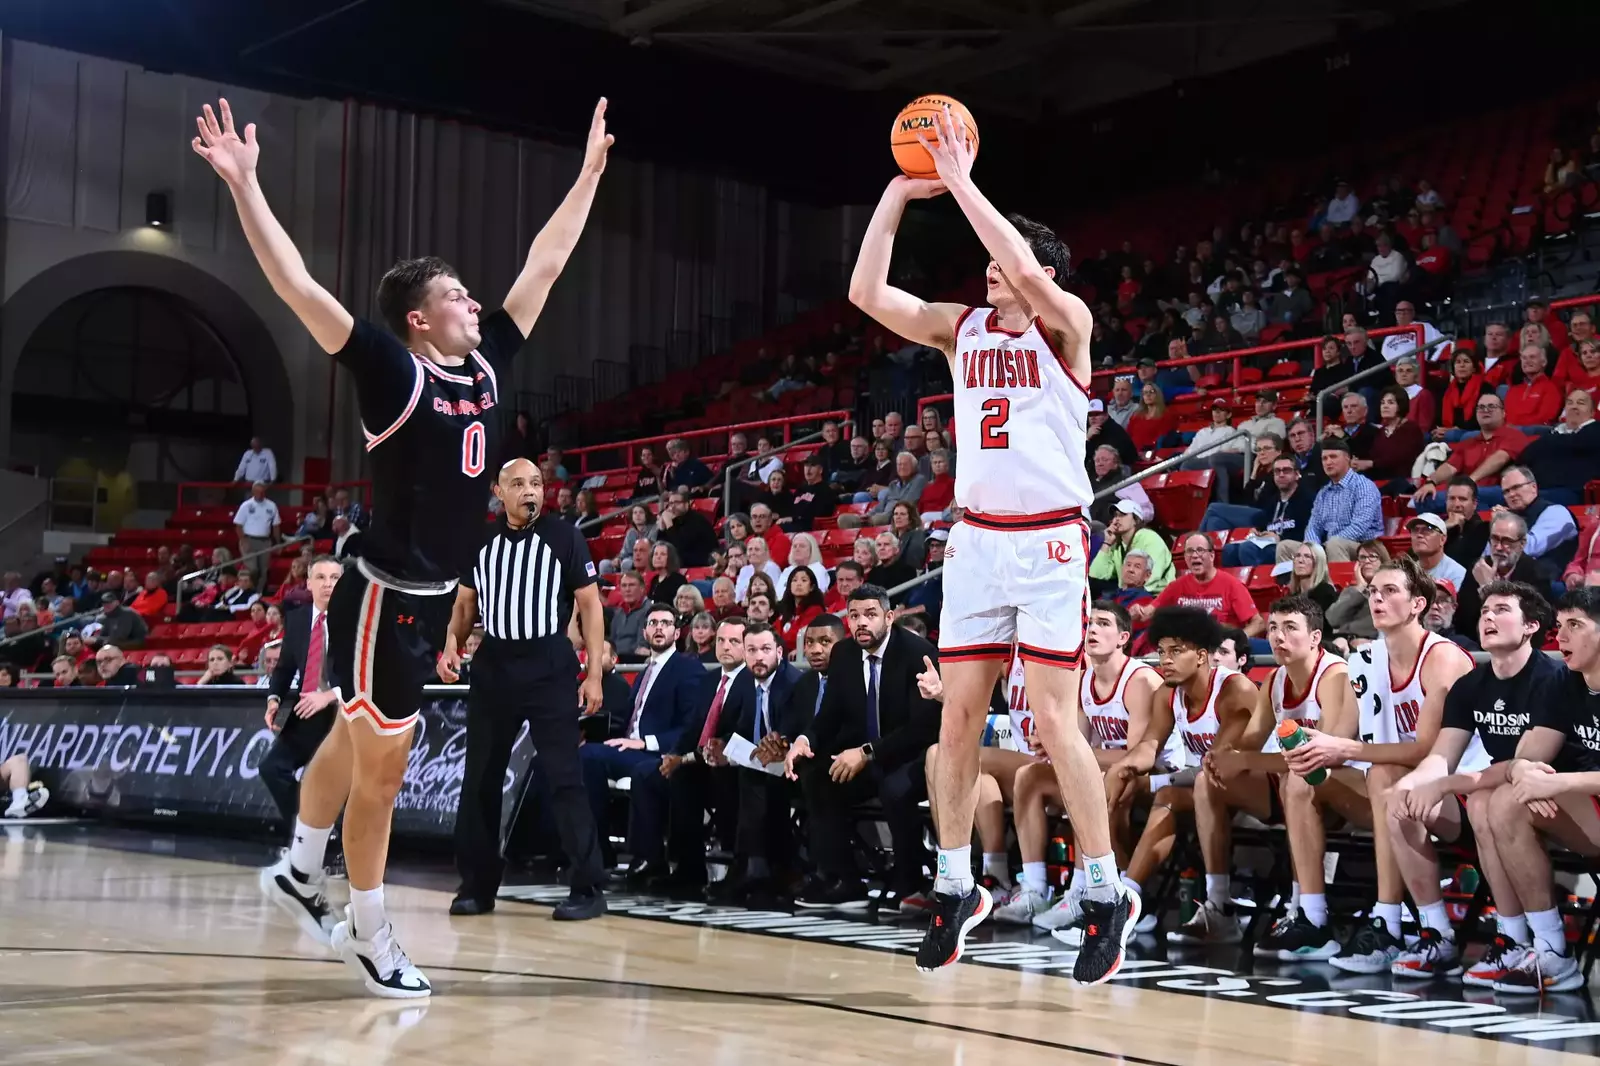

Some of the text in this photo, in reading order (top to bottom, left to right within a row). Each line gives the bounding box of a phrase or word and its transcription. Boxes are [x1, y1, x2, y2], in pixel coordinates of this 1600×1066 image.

[980, 398, 1010, 449] 2
[462, 421, 485, 477] 0
[1045, 540, 1072, 563] DC
[1473, 710, 1530, 726] DAIDSON
[1488, 726, 1521, 736] LLEGE
[1573, 725, 1600, 742] AVI
[0, 722, 304, 782] NHARDTCHEVY.C
